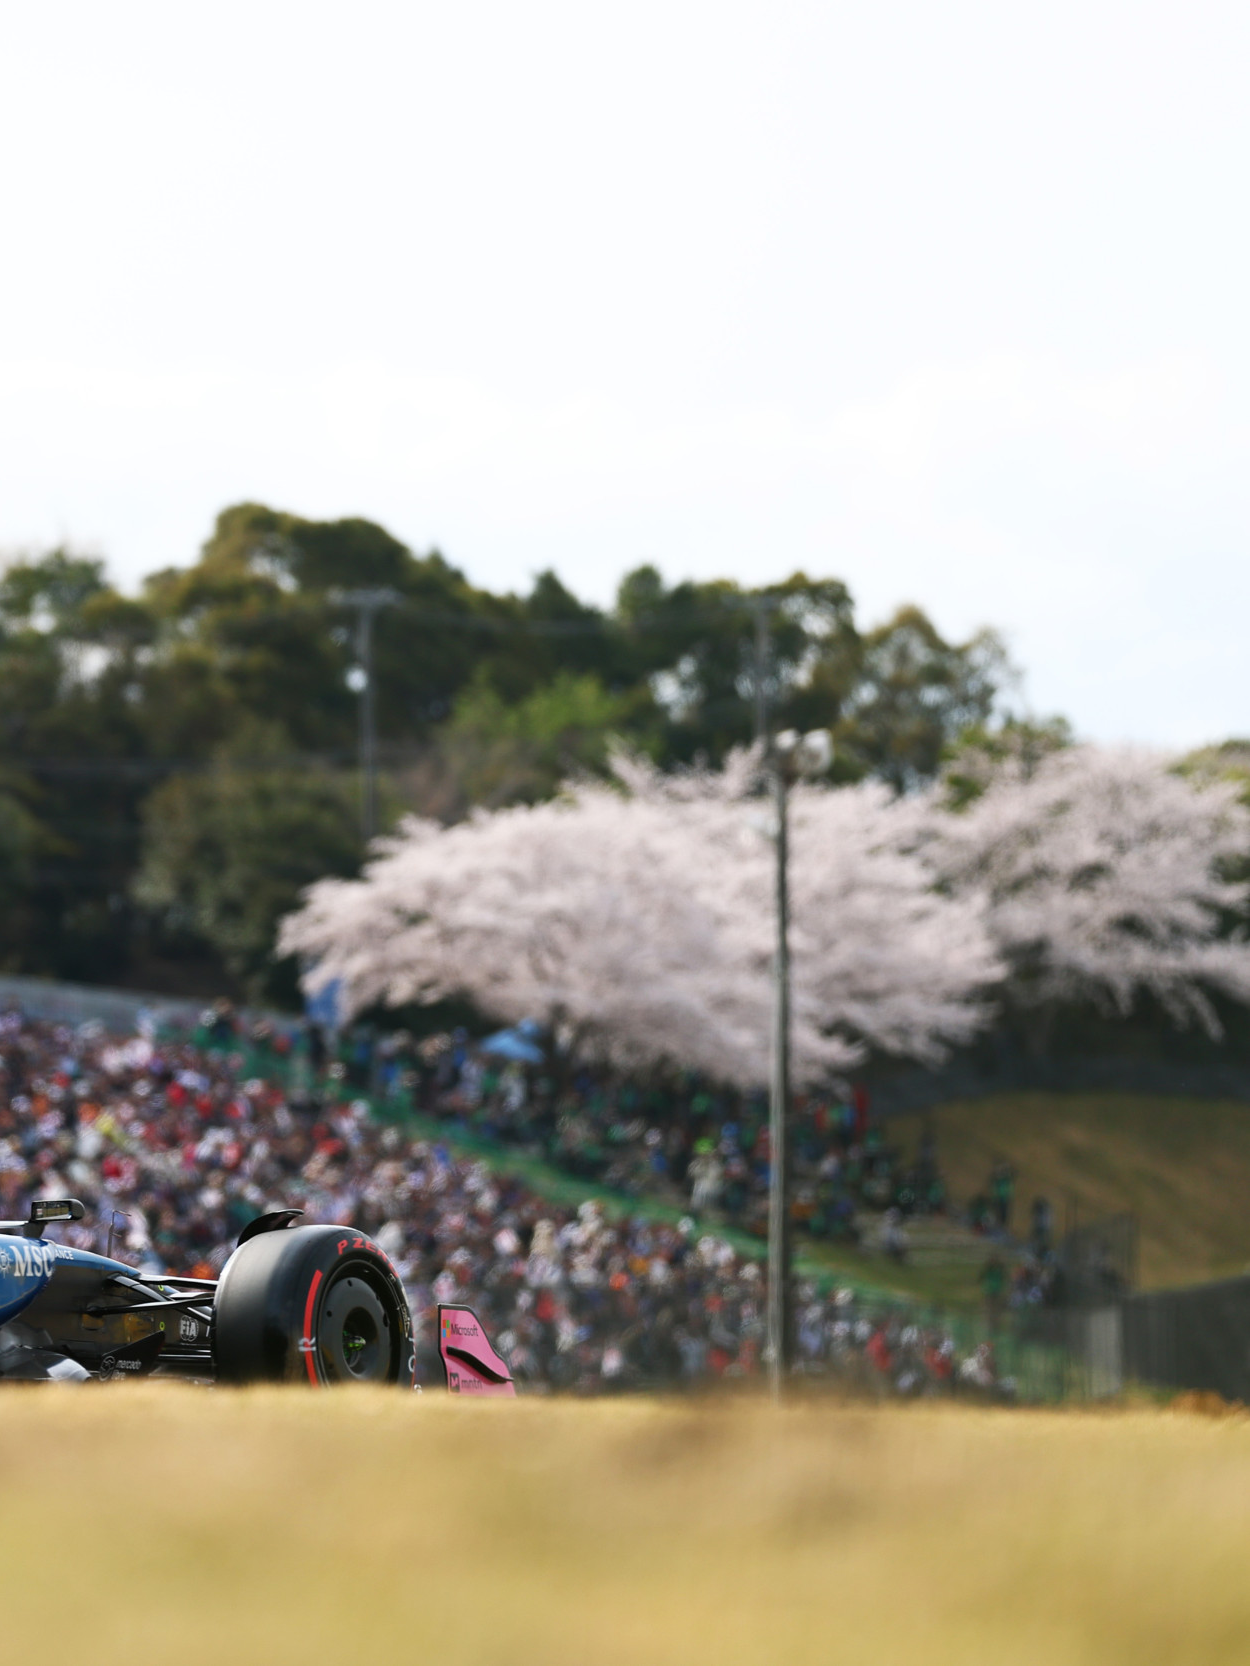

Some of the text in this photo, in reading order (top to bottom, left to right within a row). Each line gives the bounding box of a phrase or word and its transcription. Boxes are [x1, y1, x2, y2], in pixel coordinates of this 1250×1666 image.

[54, 1248, 75, 1260] ANCE
[337, 1239, 349, 1255] P
[180, 1319, 198, 1337] FIA
[451, 1323, 479, 1337] Microsoft
[116, 1359, 142, 1370] mercado
